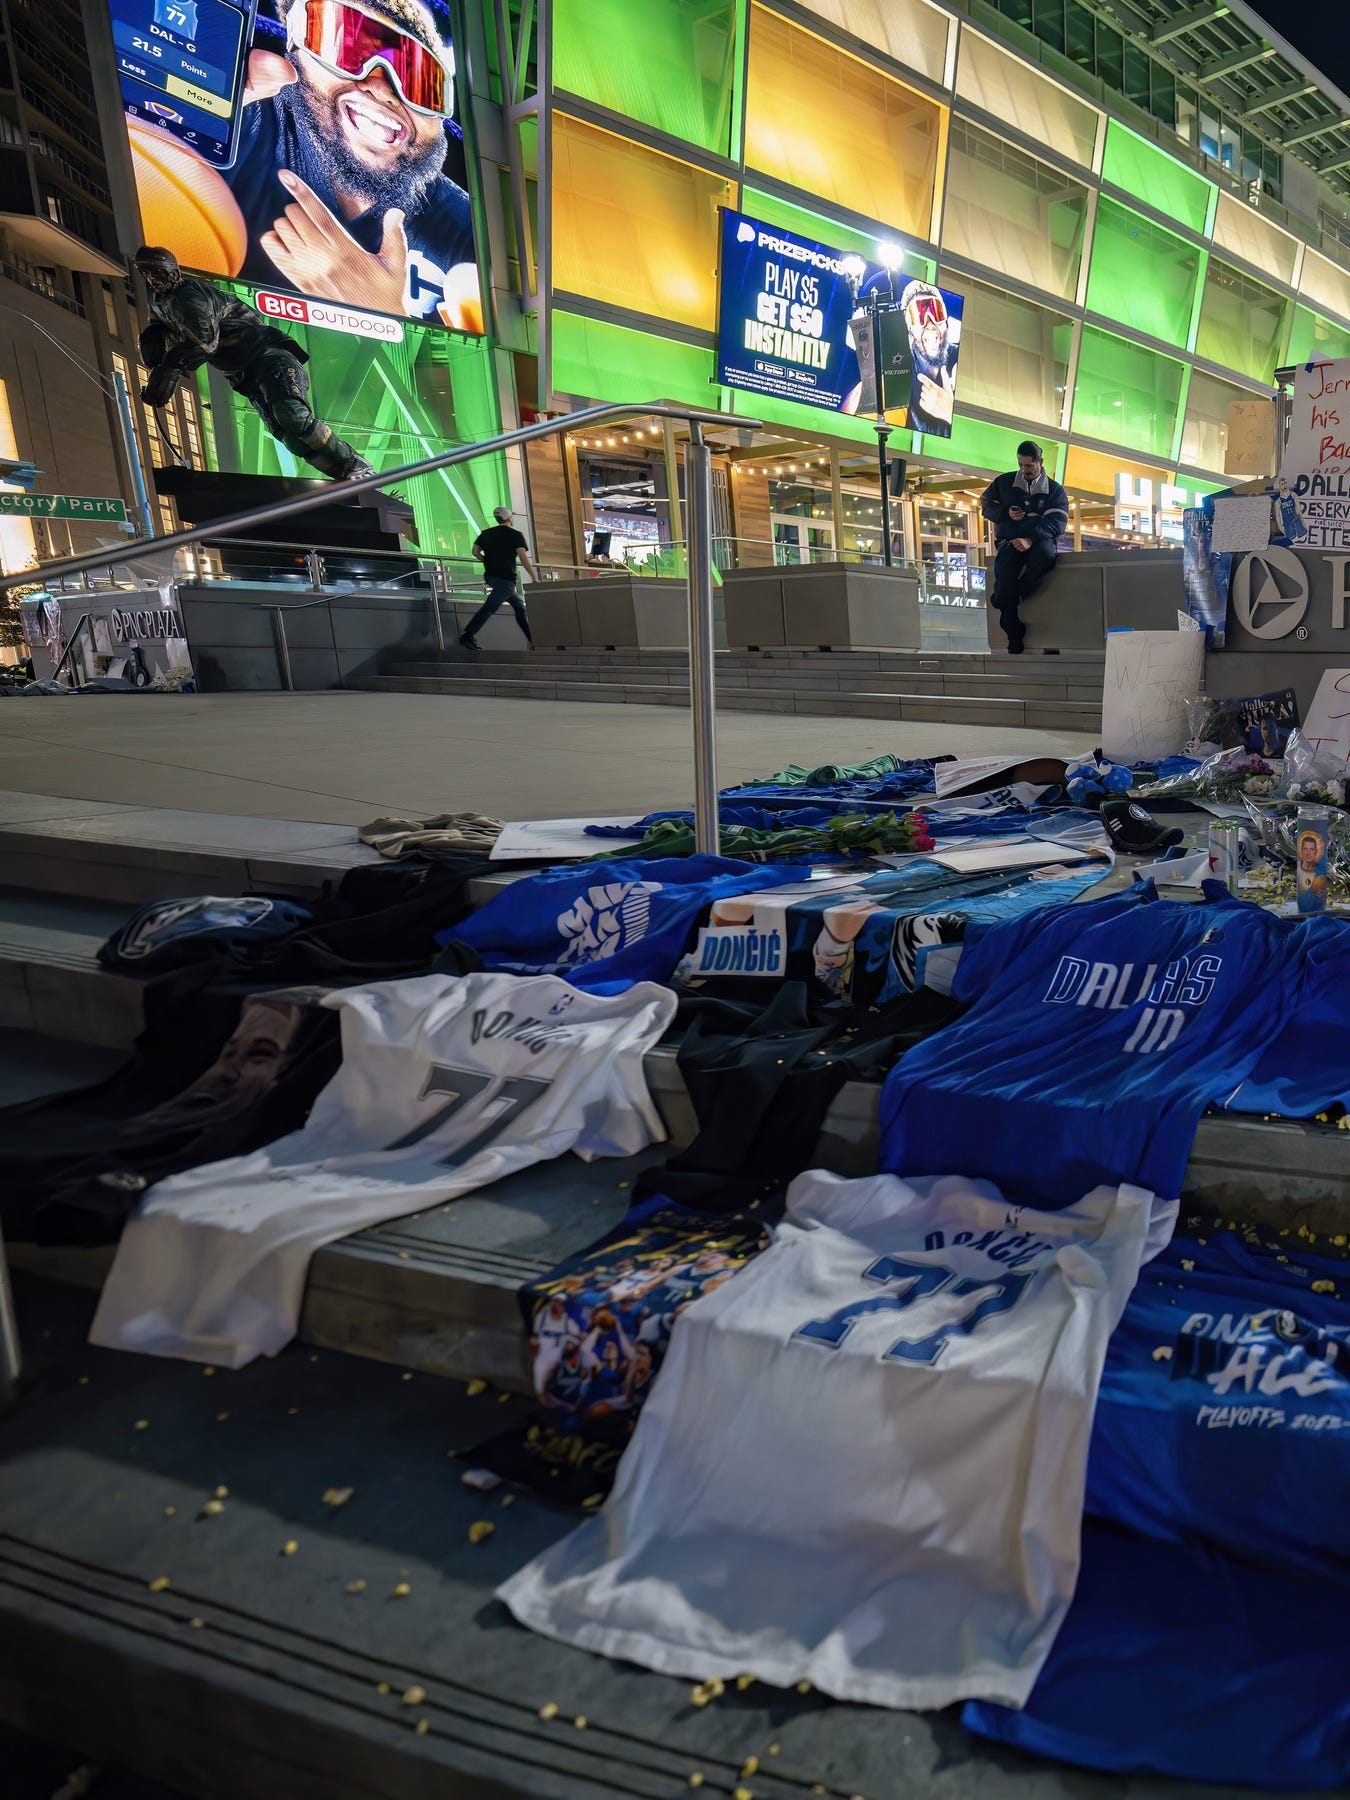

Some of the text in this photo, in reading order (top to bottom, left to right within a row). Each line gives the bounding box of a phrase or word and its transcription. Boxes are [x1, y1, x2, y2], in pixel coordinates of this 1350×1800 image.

[166, 5, 187, 26] 77
[131, 36, 162, 58] 21.5
[149, 24, 176, 44] DAL
[186, 43, 197, 53] G
[122, 59, 146, 76] Less
[181, 60, 207, 78] Points
[187, 89, 213, 106] More
[765, 261, 819, 307] PLAY $5
[264, 296, 396, 336] BIG OUTDOOR
[756, 291, 823, 338] GET $50
[744, 318, 831, 370] INSTANTLY
[1311, 406, 1340, 430] his
[70, 498, 117, 512] Park
[121, 610, 180, 638] PNC PLAZA
[700, 929, 781, 971] DONČIĆ
[1042, 954, 1223, 1010] DALLAS
[383, 1061, 556, 1168] 77
[790, 1254, 1037, 1368] 77
[1197, 1404, 1286, 1430] PLAYOFFS
